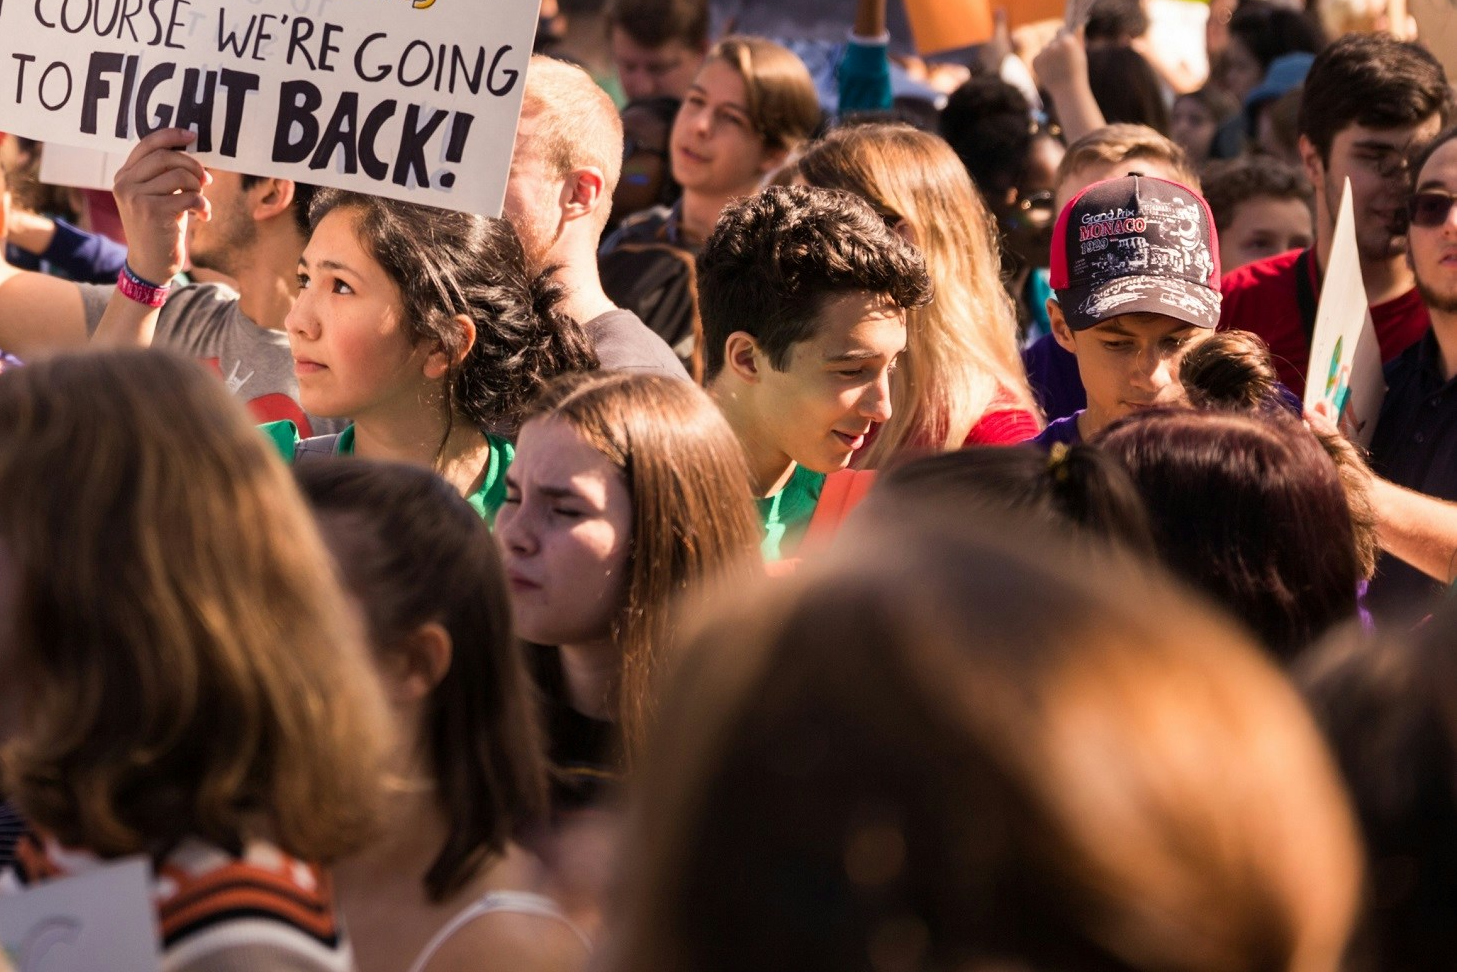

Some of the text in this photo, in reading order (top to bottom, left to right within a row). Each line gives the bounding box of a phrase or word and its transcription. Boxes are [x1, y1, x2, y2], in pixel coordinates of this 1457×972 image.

[218, 6, 343, 74] WE'RE
[355, 32, 519, 98] GOING
[12, 51, 475, 189] TO FIGHT BACK!
[1082, 209, 1114, 224] Grand
[1117, 208, 1135, 219] Prix
[1079, 218, 1146, 241] MONACO
[1080, 238, 1109, 254] 1929
